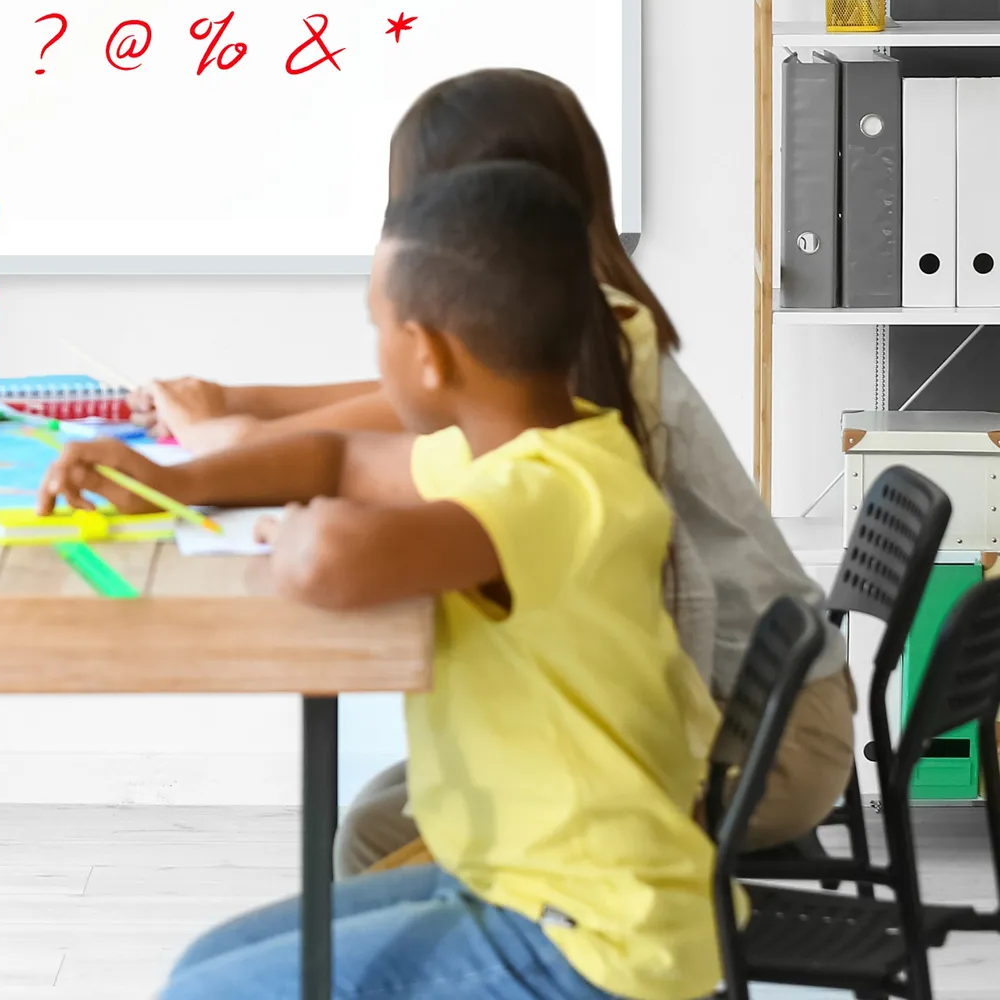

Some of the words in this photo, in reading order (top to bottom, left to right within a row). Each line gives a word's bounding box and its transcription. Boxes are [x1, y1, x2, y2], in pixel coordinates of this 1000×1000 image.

[34, 12, 68, 76] ?
[104, 19, 153, 72] @
[188, 10, 248, 77] %
[284, 13, 347, 77] &
